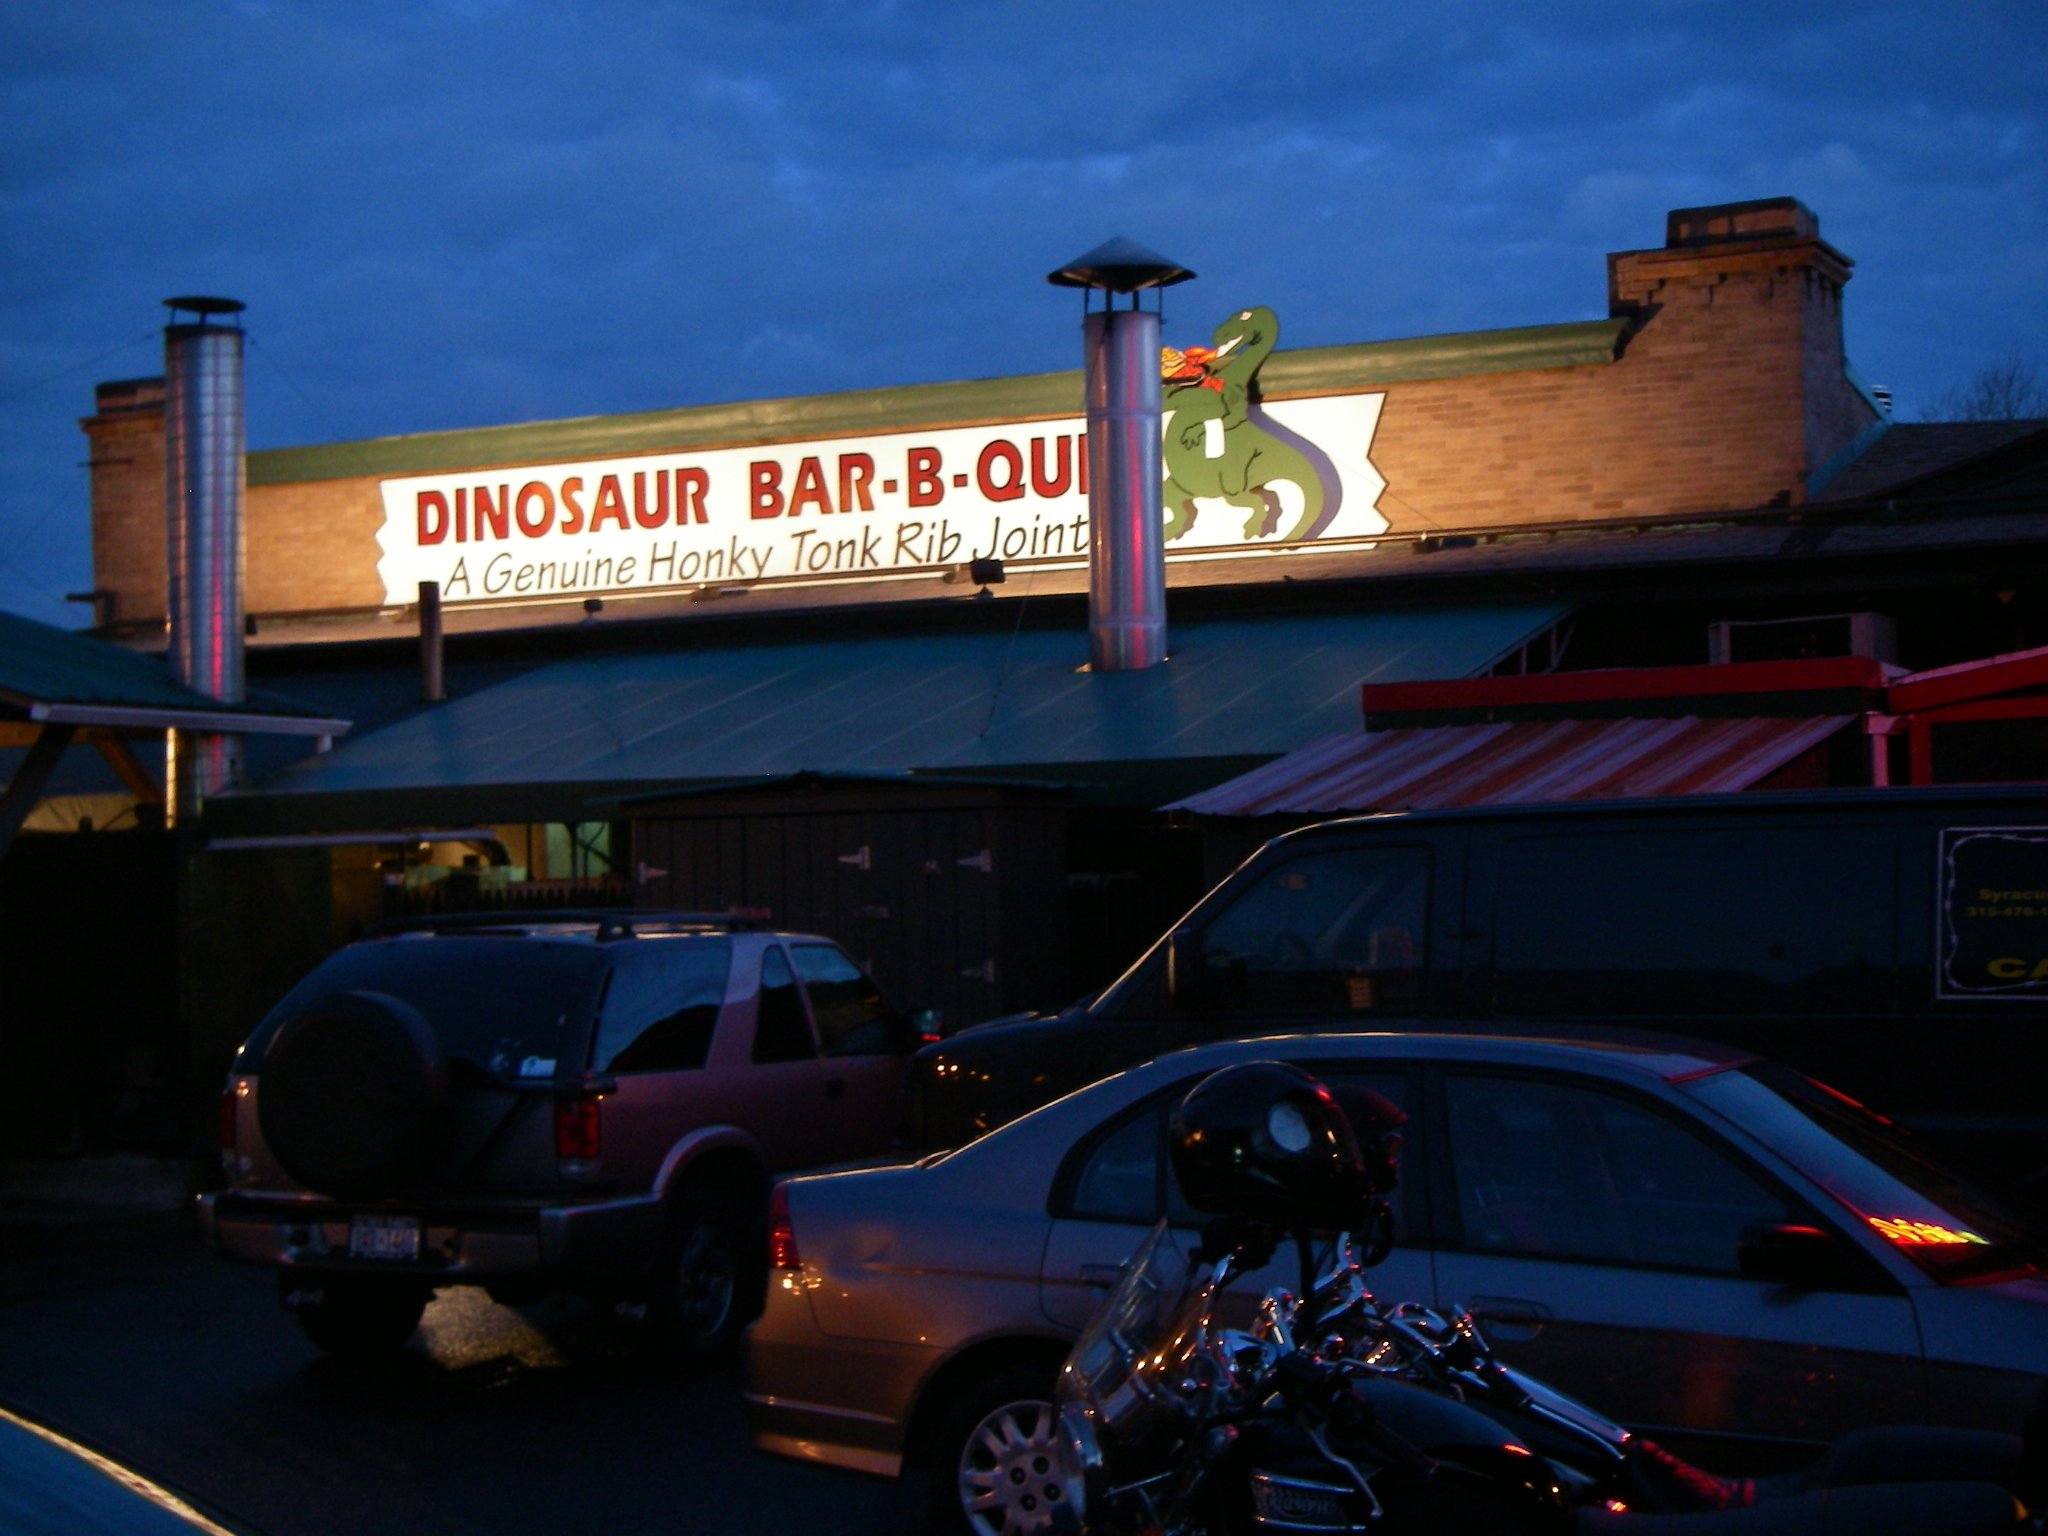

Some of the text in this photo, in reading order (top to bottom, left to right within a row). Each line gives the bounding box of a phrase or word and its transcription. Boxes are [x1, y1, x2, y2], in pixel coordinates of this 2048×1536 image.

[417, 466, 710, 546] DINOSAUR
[443, 513, 1089, 596] A Genuine Honky Tonk Rib Joint
